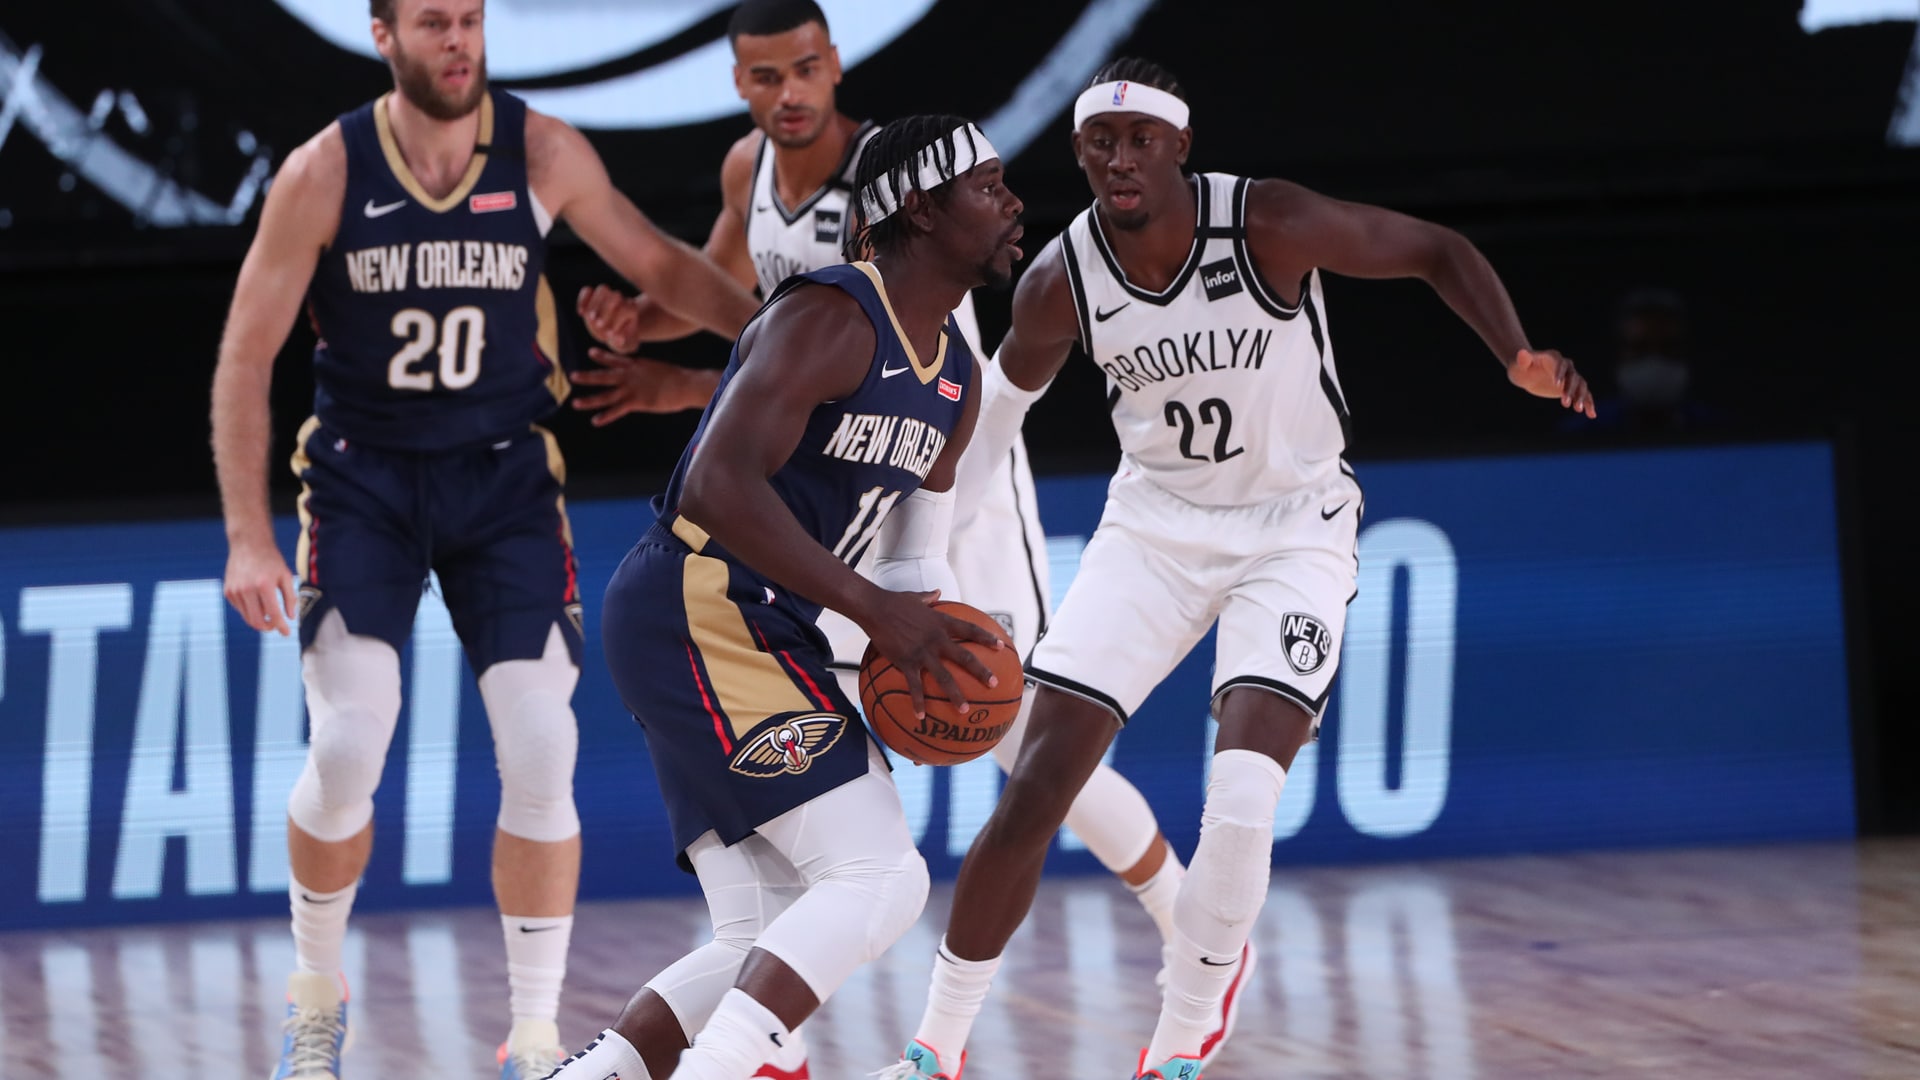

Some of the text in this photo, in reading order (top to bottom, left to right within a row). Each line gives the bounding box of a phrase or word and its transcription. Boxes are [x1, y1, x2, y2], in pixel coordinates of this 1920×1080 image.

[346, 240, 529, 293] NEW ORLEANS
[1204, 270, 1236, 289] infor
[388, 305, 486, 391] 20
[1103, 328, 1273, 392] BROOKLYN
[822, 413, 899, 464] NEW
[1164, 397, 1244, 463] 22
[832, 486, 902, 565] 11
[1284, 616, 1330, 656] NETS
[1298, 644, 1311, 666] B
[914, 712, 1017, 742] SPALDIN
